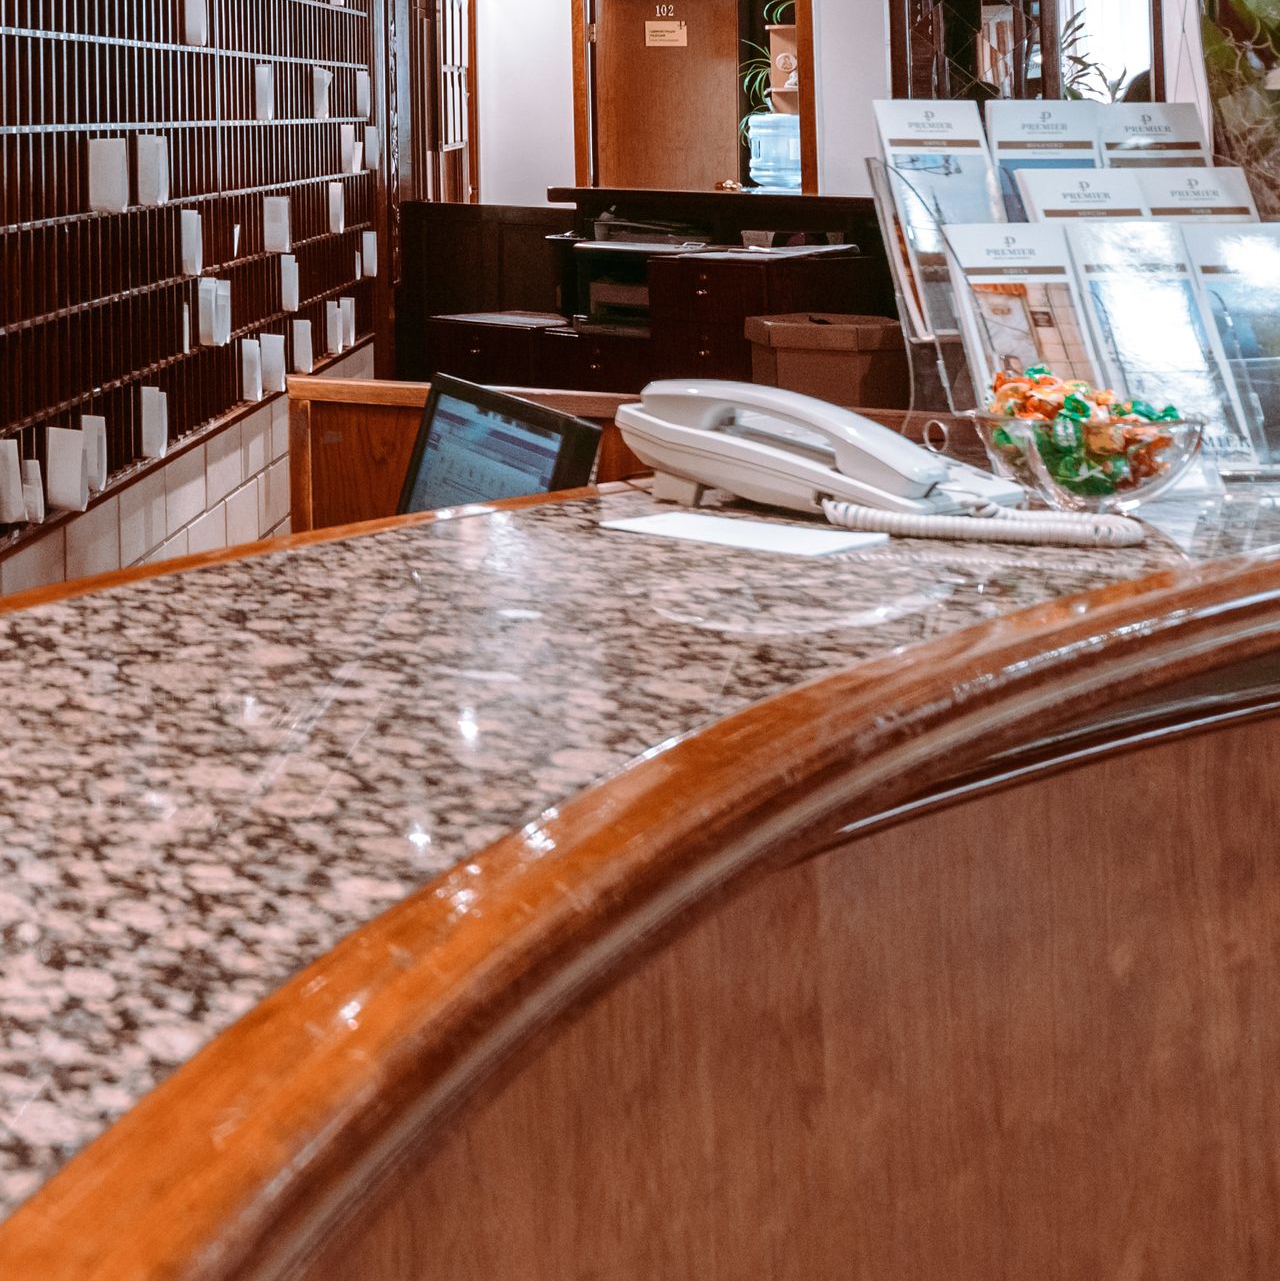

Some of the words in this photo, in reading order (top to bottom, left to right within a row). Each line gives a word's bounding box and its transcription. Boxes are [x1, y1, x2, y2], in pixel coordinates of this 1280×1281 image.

[655, 4, 674, 17] 102
[1021, 123, 1068, 131] PREMIER
[1123, 125, 1172, 133] PREMIER
[985, 248, 1036, 256] PREMIER
